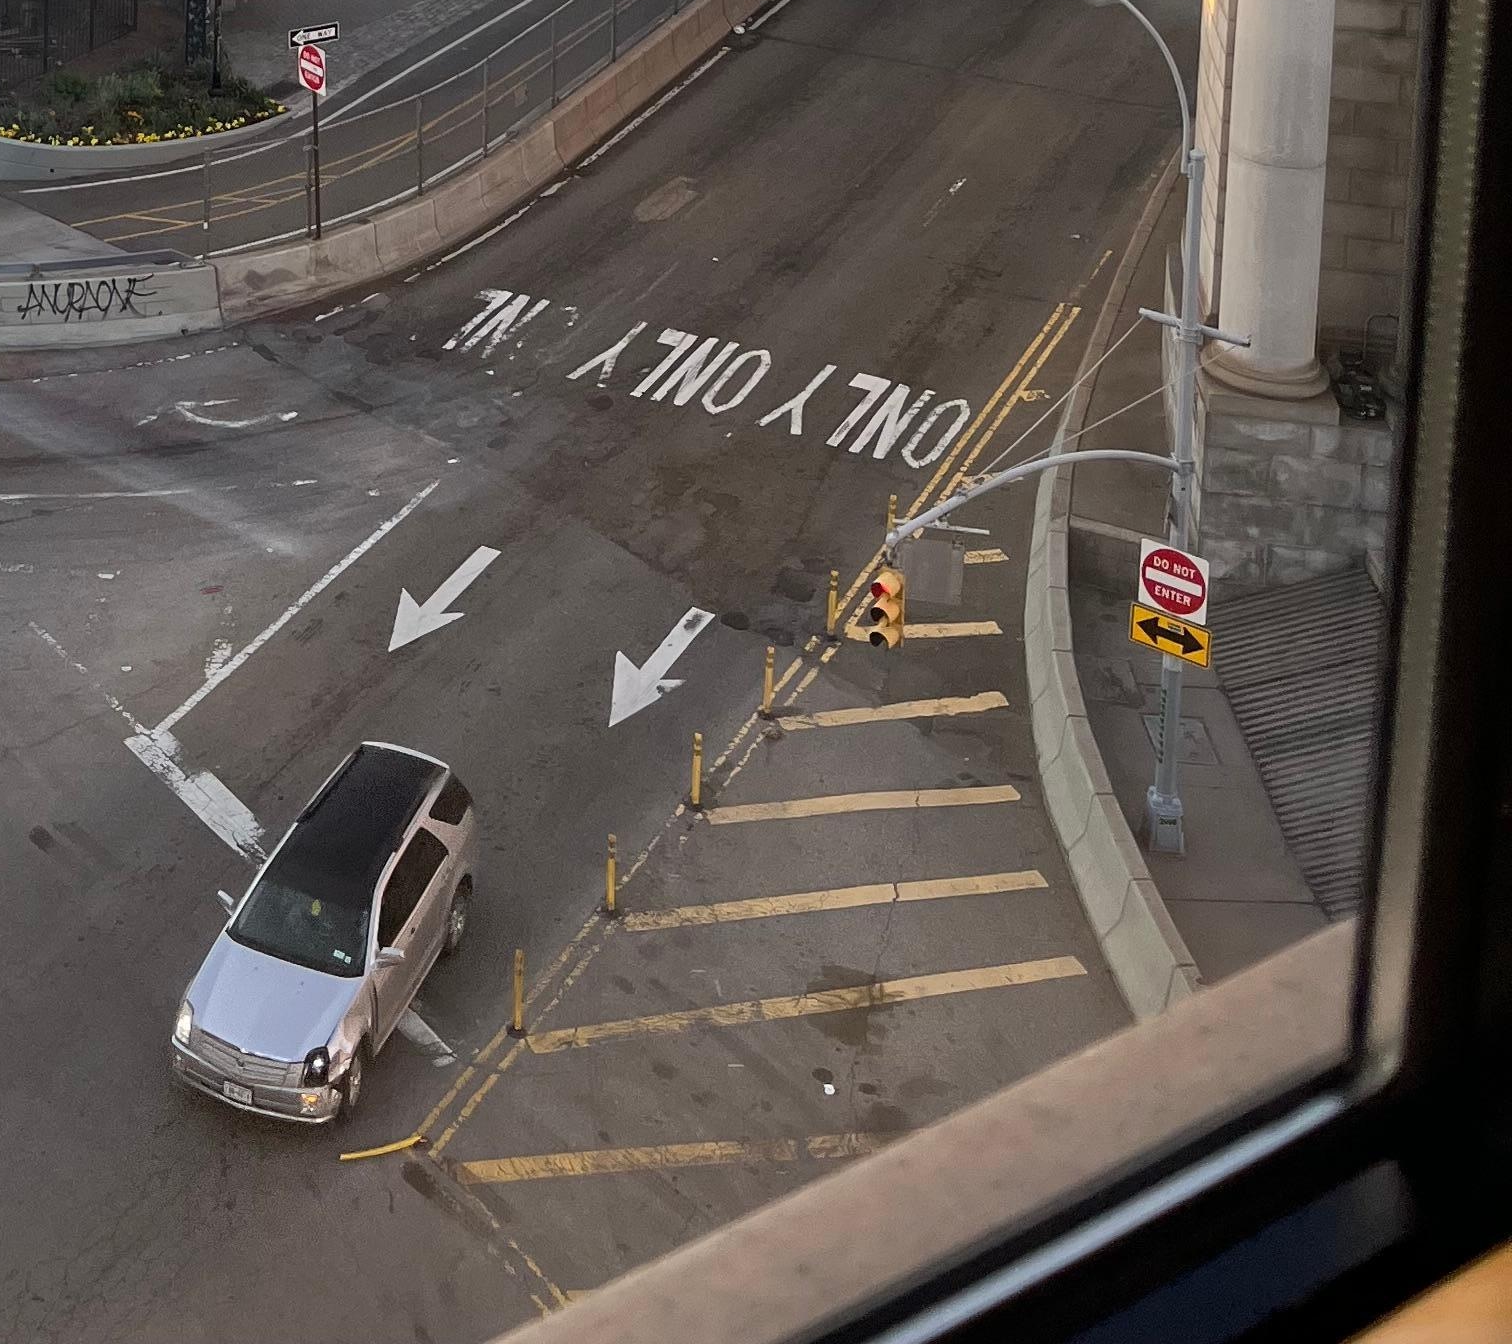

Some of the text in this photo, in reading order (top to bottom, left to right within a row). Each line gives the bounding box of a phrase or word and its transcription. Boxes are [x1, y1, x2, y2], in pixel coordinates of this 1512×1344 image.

[297, 32, 311, 41] ONE
[566, 321, 772, 415] ONLY
[754, 364, 971, 469] ONLY
[1153, 555, 1197, 581] DO NOT
[1154, 585, 1192, 607] ENTER
